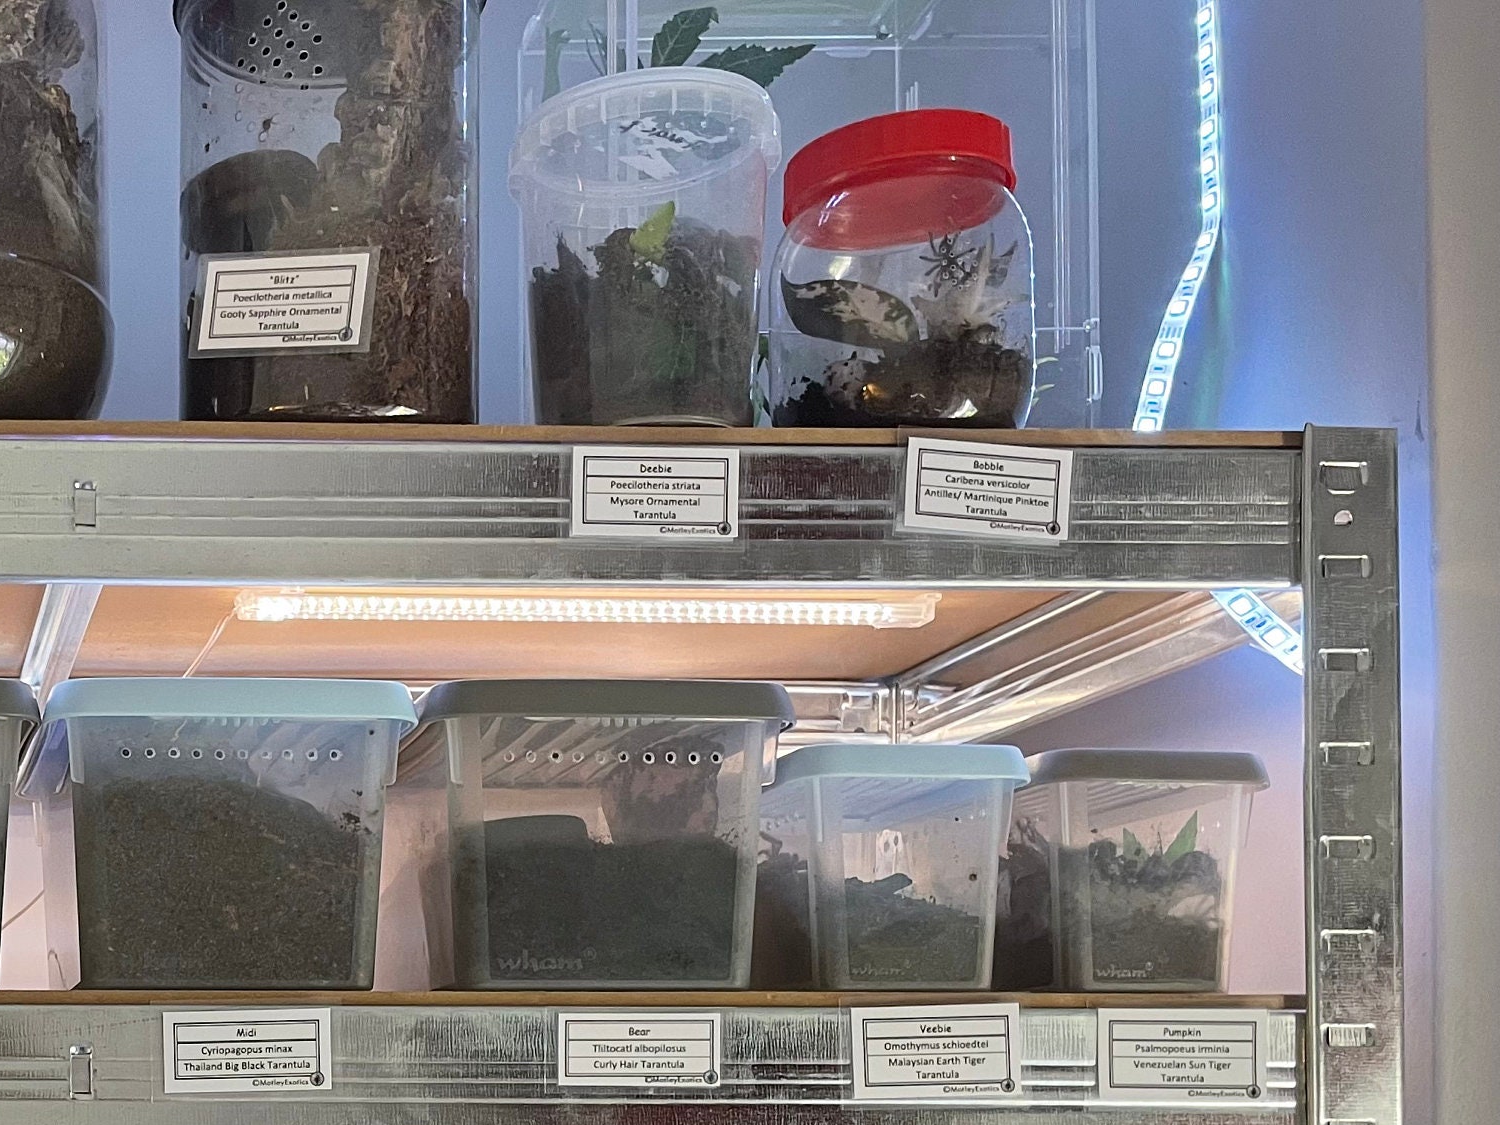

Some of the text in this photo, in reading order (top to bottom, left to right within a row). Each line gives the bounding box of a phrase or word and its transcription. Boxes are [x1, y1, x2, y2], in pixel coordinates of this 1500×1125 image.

[233, 292, 332, 302] Poecilotheria metallica
[220, 306, 342, 320] Gooty Sapphire Ornamental
[258, 322, 299, 330] Tarantula
[640, 464, 672, 473] Deebie
[610, 481, 700, 490] Poecilotheria striata
[945, 475, 1030, 489] Caribena versicolor
[610, 497, 700, 507] Mysore Ornamental
[924, 489, 1049, 507] Antilles/ Martinique Pinktoe
[634, 511, 676, 519] Tarantula
[965, 505, 1007, 516] Tarantula
[237, 1028, 257, 1037] Midi
[628, 1027, 651, 1036] Bear
[920, 1024, 952, 1033] Veebie
[1163, 1028, 1201, 1038] Pumpkin
[634, 1044, 686, 1053] albopilosus
[884, 1040, 988, 1052] Omothymus schioedtei
[1135, 1045, 1229, 1054] Psalmopoeus irminia
[201, 1046, 263, 1056] Cyriopagopus
[184, 1060, 311, 1071] Thailand Big Black Tarantula
[593, 1060, 685, 1069] Curly Hair Tarantula
[888, 1056, 986, 1067] Malaysian Earth Tiger
[1133, 1061, 1231, 1070] Venezuelan Sun Tiger
[916, 1070, 959, 1079] Tarantula
[1161, 1074, 1204, 1082] Tarantula
